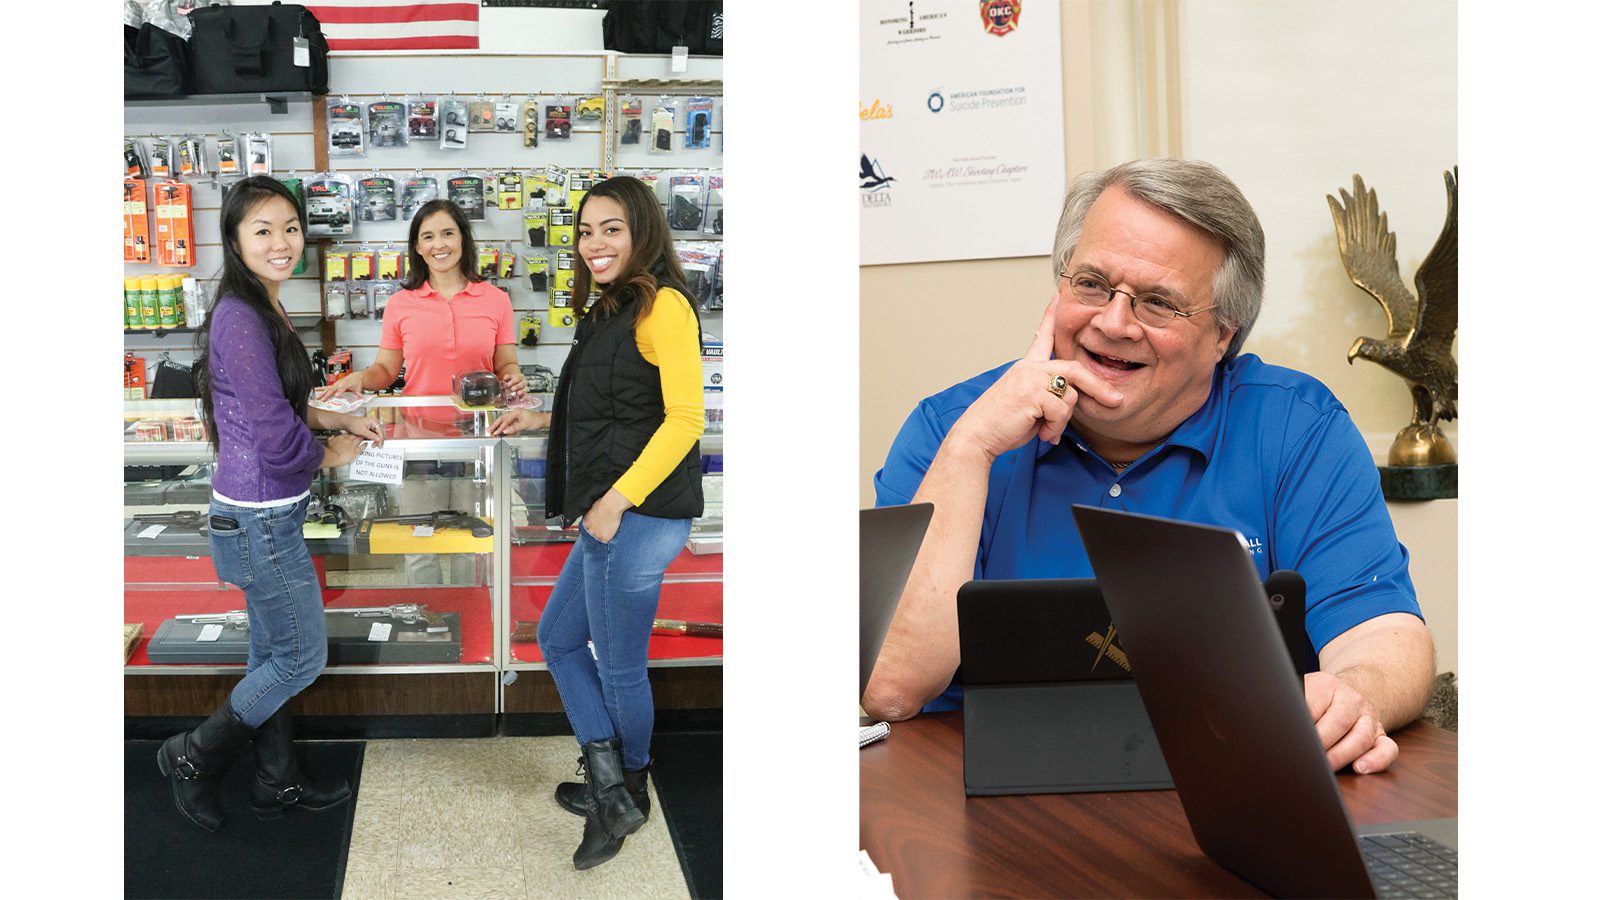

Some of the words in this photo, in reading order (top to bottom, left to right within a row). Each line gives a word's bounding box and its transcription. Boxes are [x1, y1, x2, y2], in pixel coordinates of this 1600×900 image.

[989, 6, 1012, 17] OKC
[950, 91, 978, 99] AMERICAN
[979, 88, 1013, 96] FOUNDATION
[859, 98, 893, 120] ela's
[950, 99, 980, 111] Suicide
[981, 96, 1027, 108] Prevention
[862, 192, 892, 204] DELTA
[376, 452, 403, 460] PICTURES
[369, 471, 397, 480] ALLOWED
